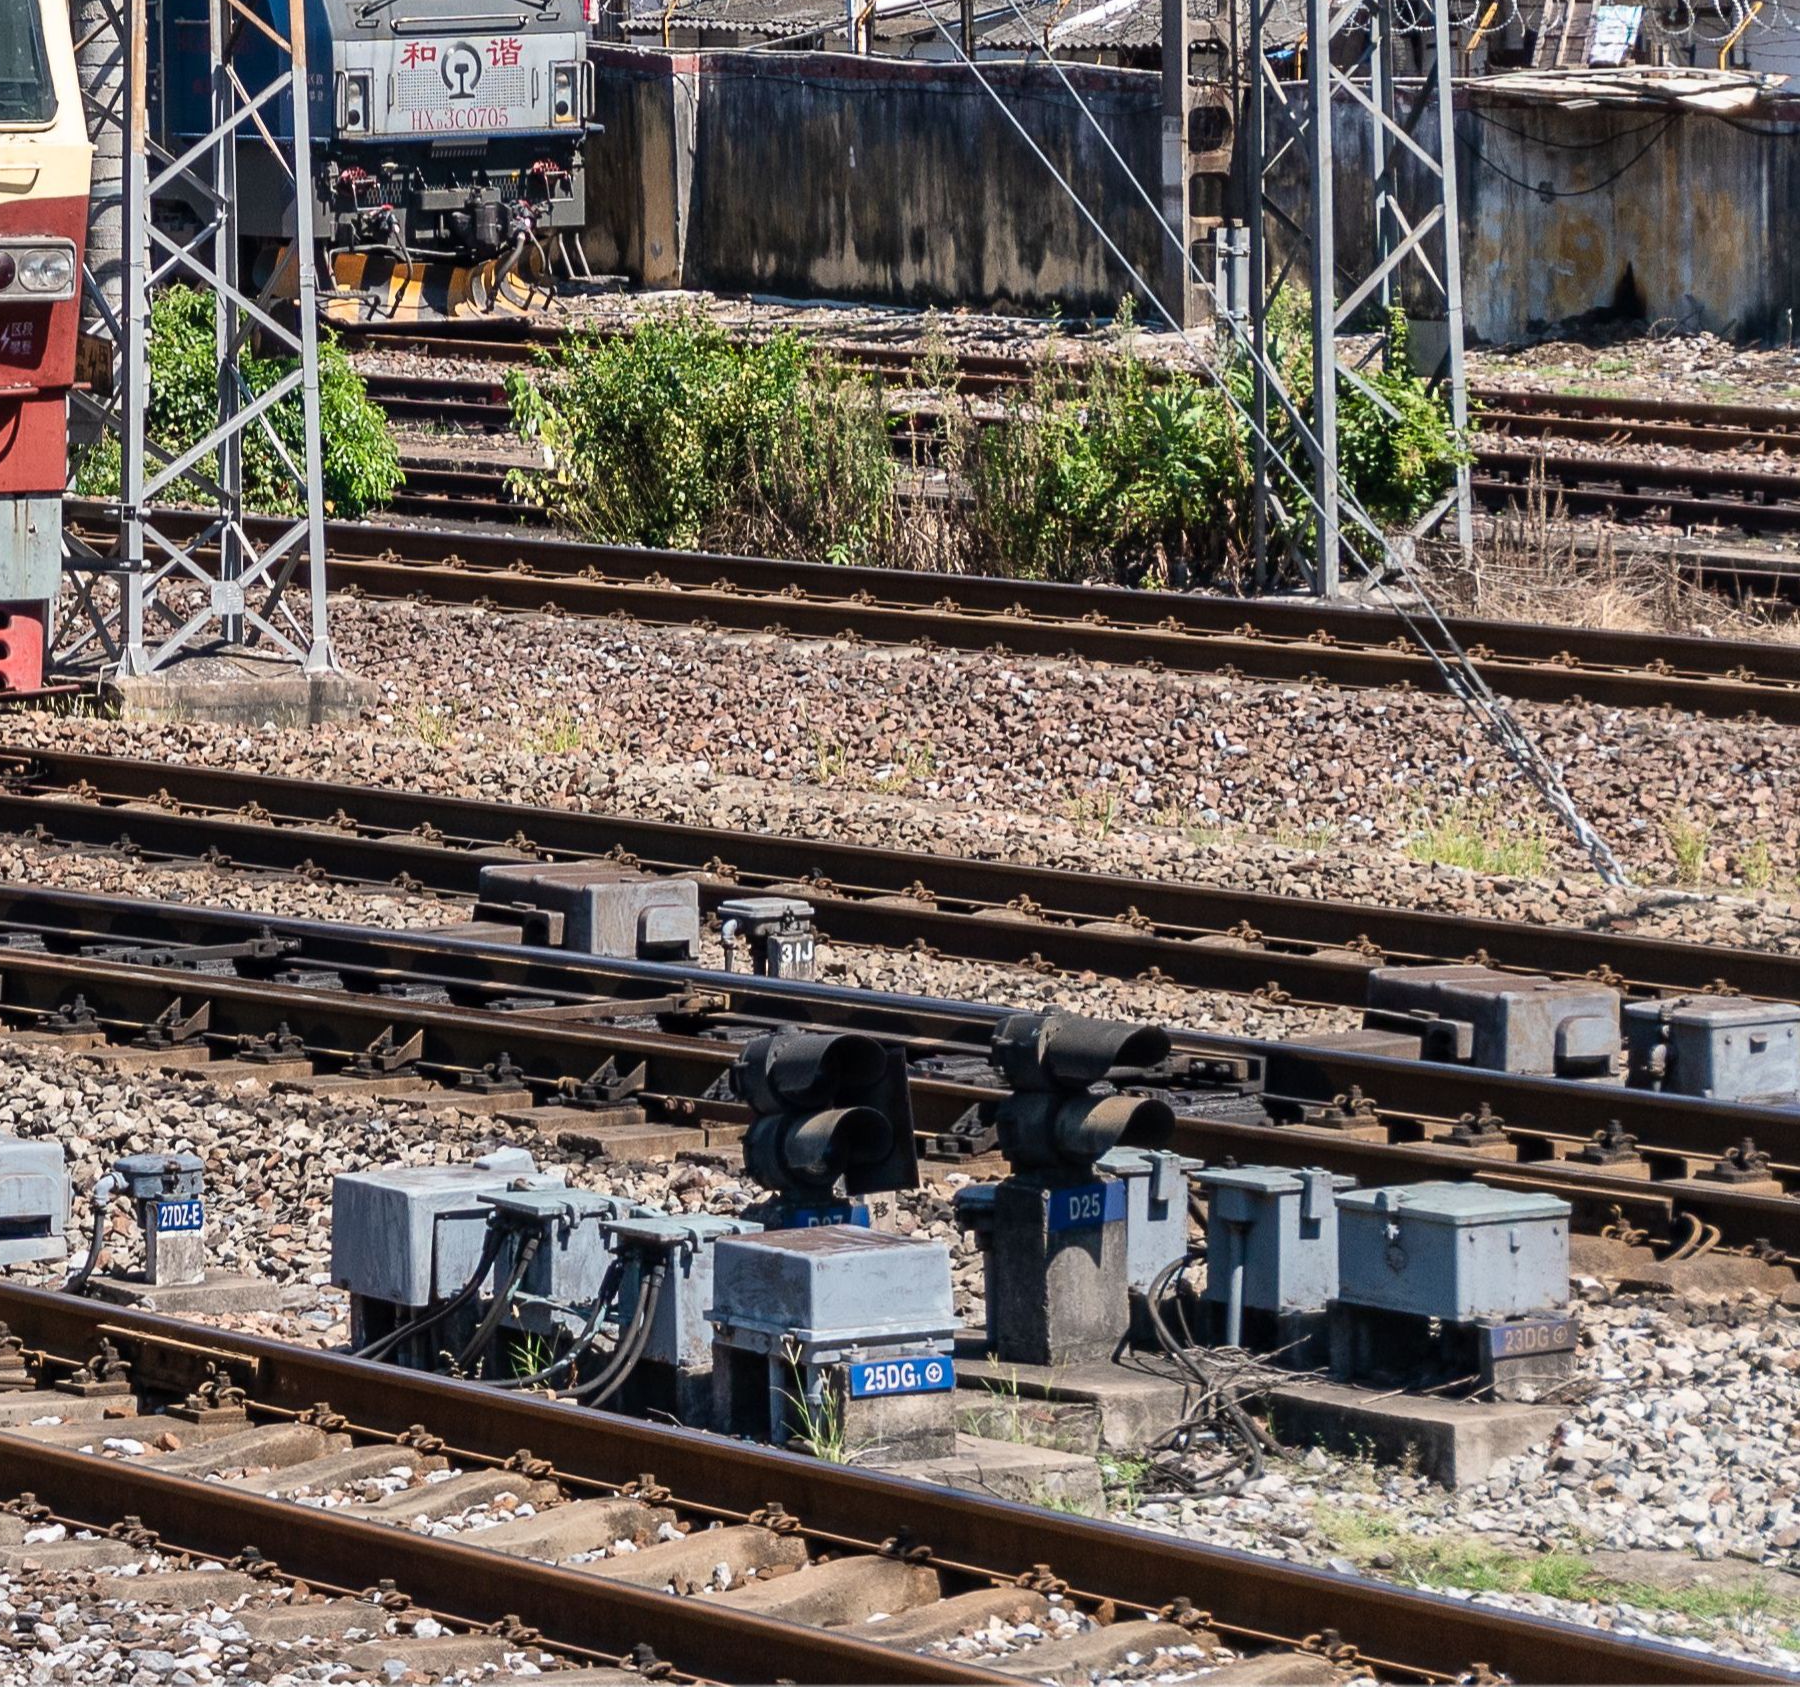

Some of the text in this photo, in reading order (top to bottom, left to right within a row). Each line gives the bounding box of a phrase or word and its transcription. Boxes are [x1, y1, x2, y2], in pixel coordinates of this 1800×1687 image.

[400, 38, 522, 70] 和 谐
[411, 107, 509, 131] HXD3C0705
[161, 1203, 201, 1227] 27DZ-E
[1069, 1193, 1101, 1220] D25
[1504, 1325, 1549, 1352] 23DG
